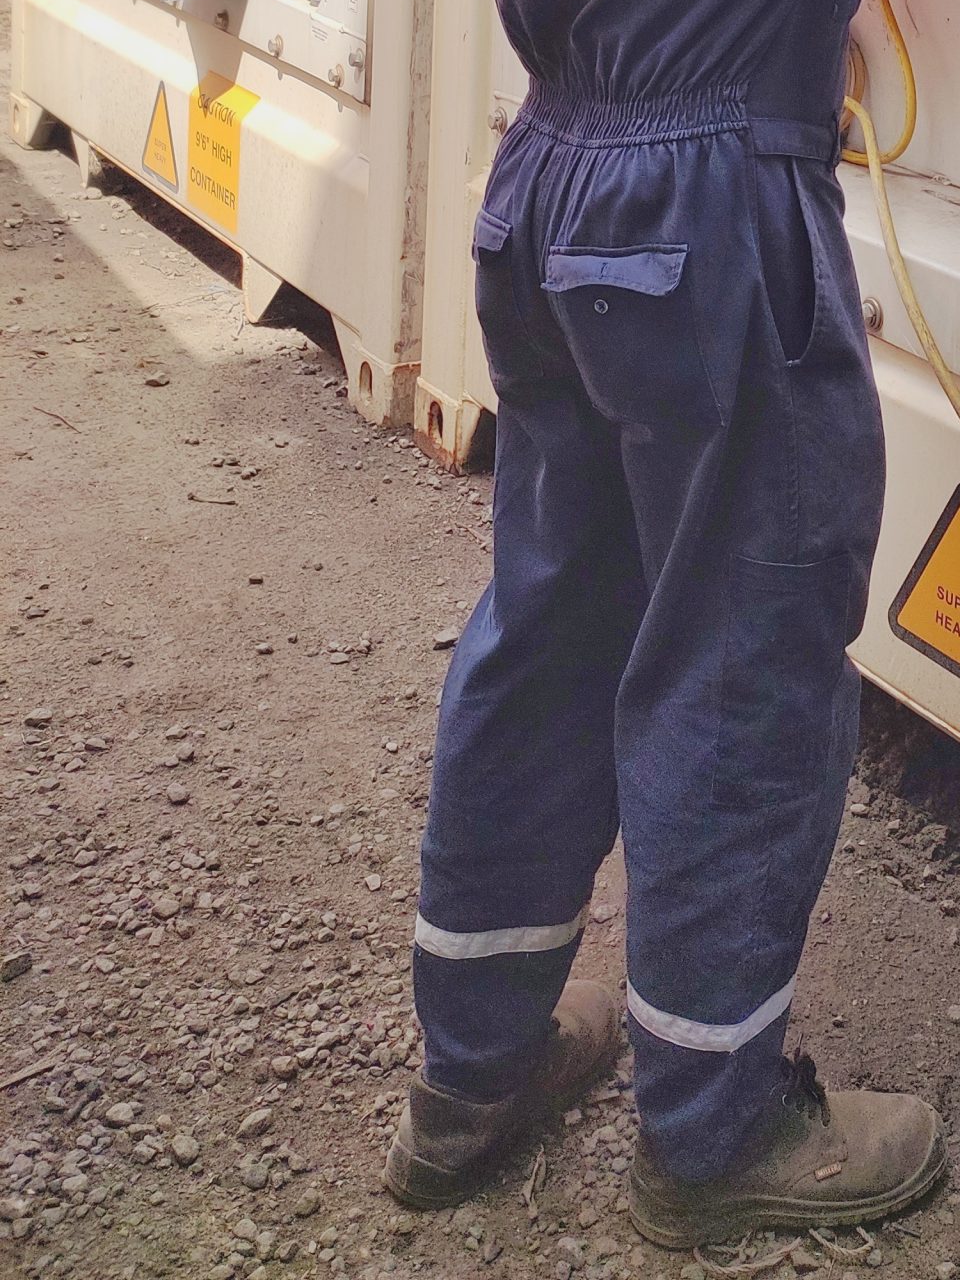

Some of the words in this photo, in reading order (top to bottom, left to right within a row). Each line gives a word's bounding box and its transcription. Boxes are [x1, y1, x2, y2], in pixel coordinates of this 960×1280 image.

[198, 93, 236, 128] CAUTION
[211, 140, 232, 167] HIGH
[190, 166, 236, 211] CONTAINER
